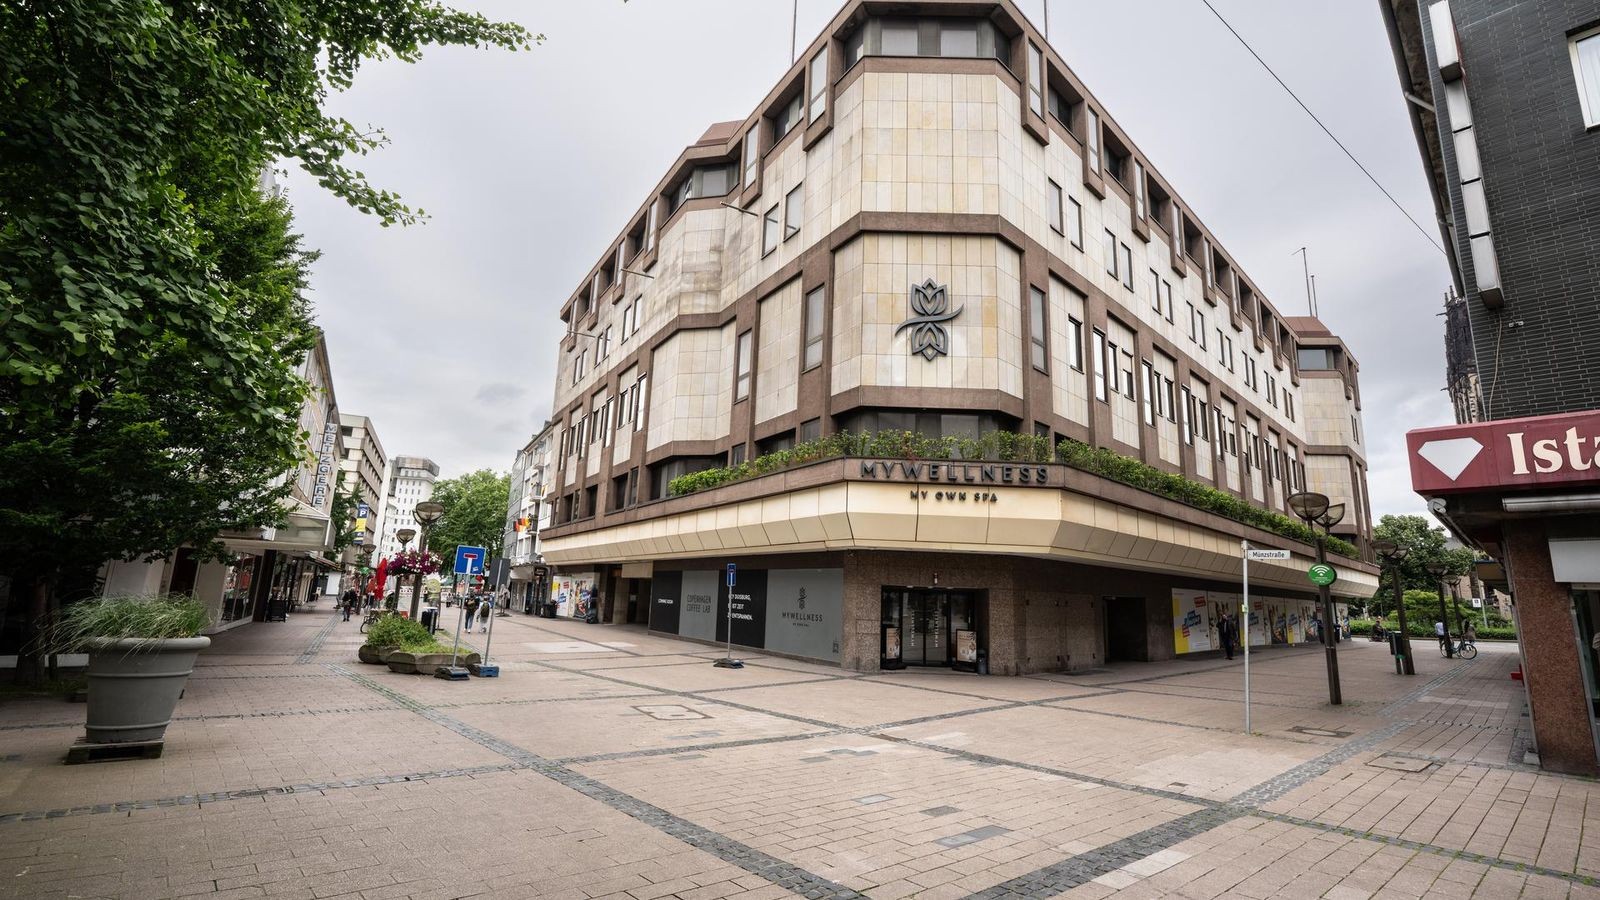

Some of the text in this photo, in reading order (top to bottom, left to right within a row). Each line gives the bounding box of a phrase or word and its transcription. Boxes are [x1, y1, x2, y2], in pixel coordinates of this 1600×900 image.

[1507, 426, 1600, 475] Ist
[861, 460, 1048, 483] MYWELLNESS
[910, 490, 998, 504] MY OWN SPA
[359, 510, 367, 518] P
[782, 612, 823, 622] MYWELLNESS
